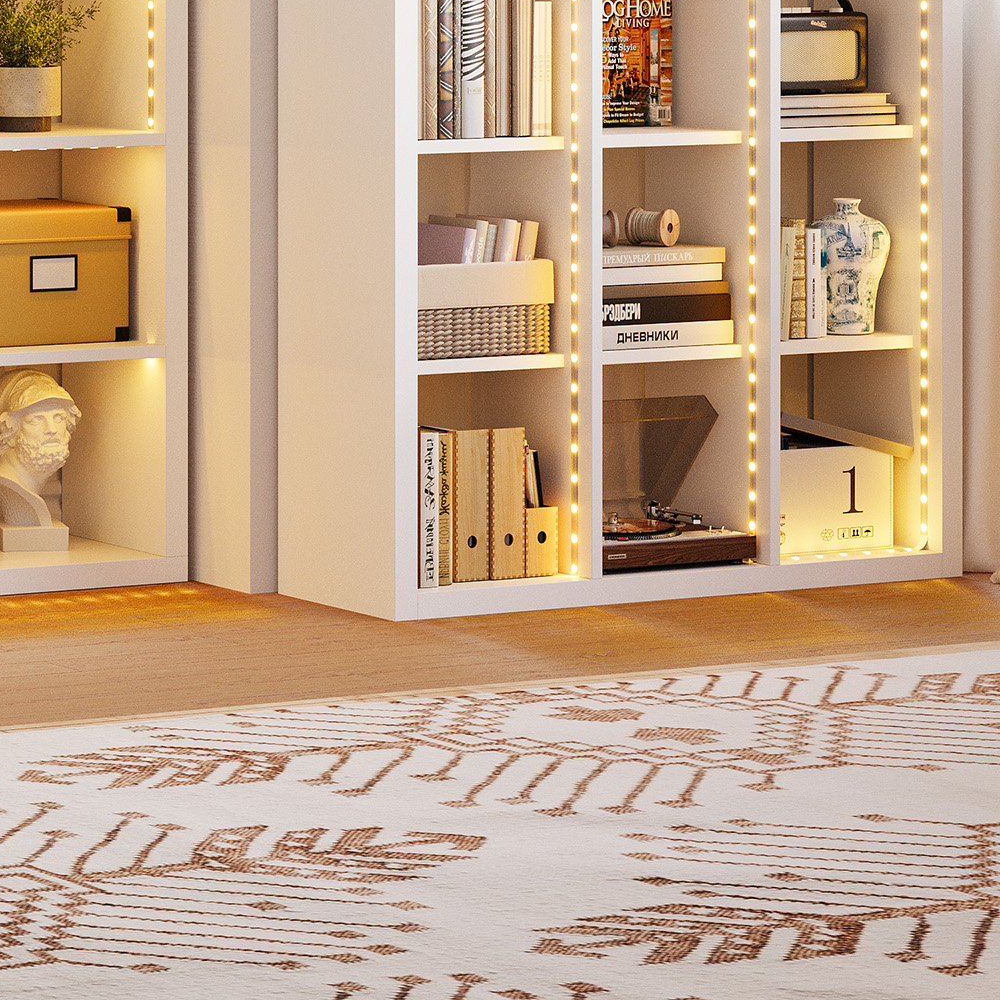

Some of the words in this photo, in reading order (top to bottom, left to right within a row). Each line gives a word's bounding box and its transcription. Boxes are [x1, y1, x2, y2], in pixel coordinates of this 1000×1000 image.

[616, 18, 651, 28] LIVING
[618, 43, 637, 53] Style
[654, 252, 695, 262] ПИСКАРЬ
[617, 330, 679, 344] ДНЕВНИКИ
[842, 465, 864, 515] 1
